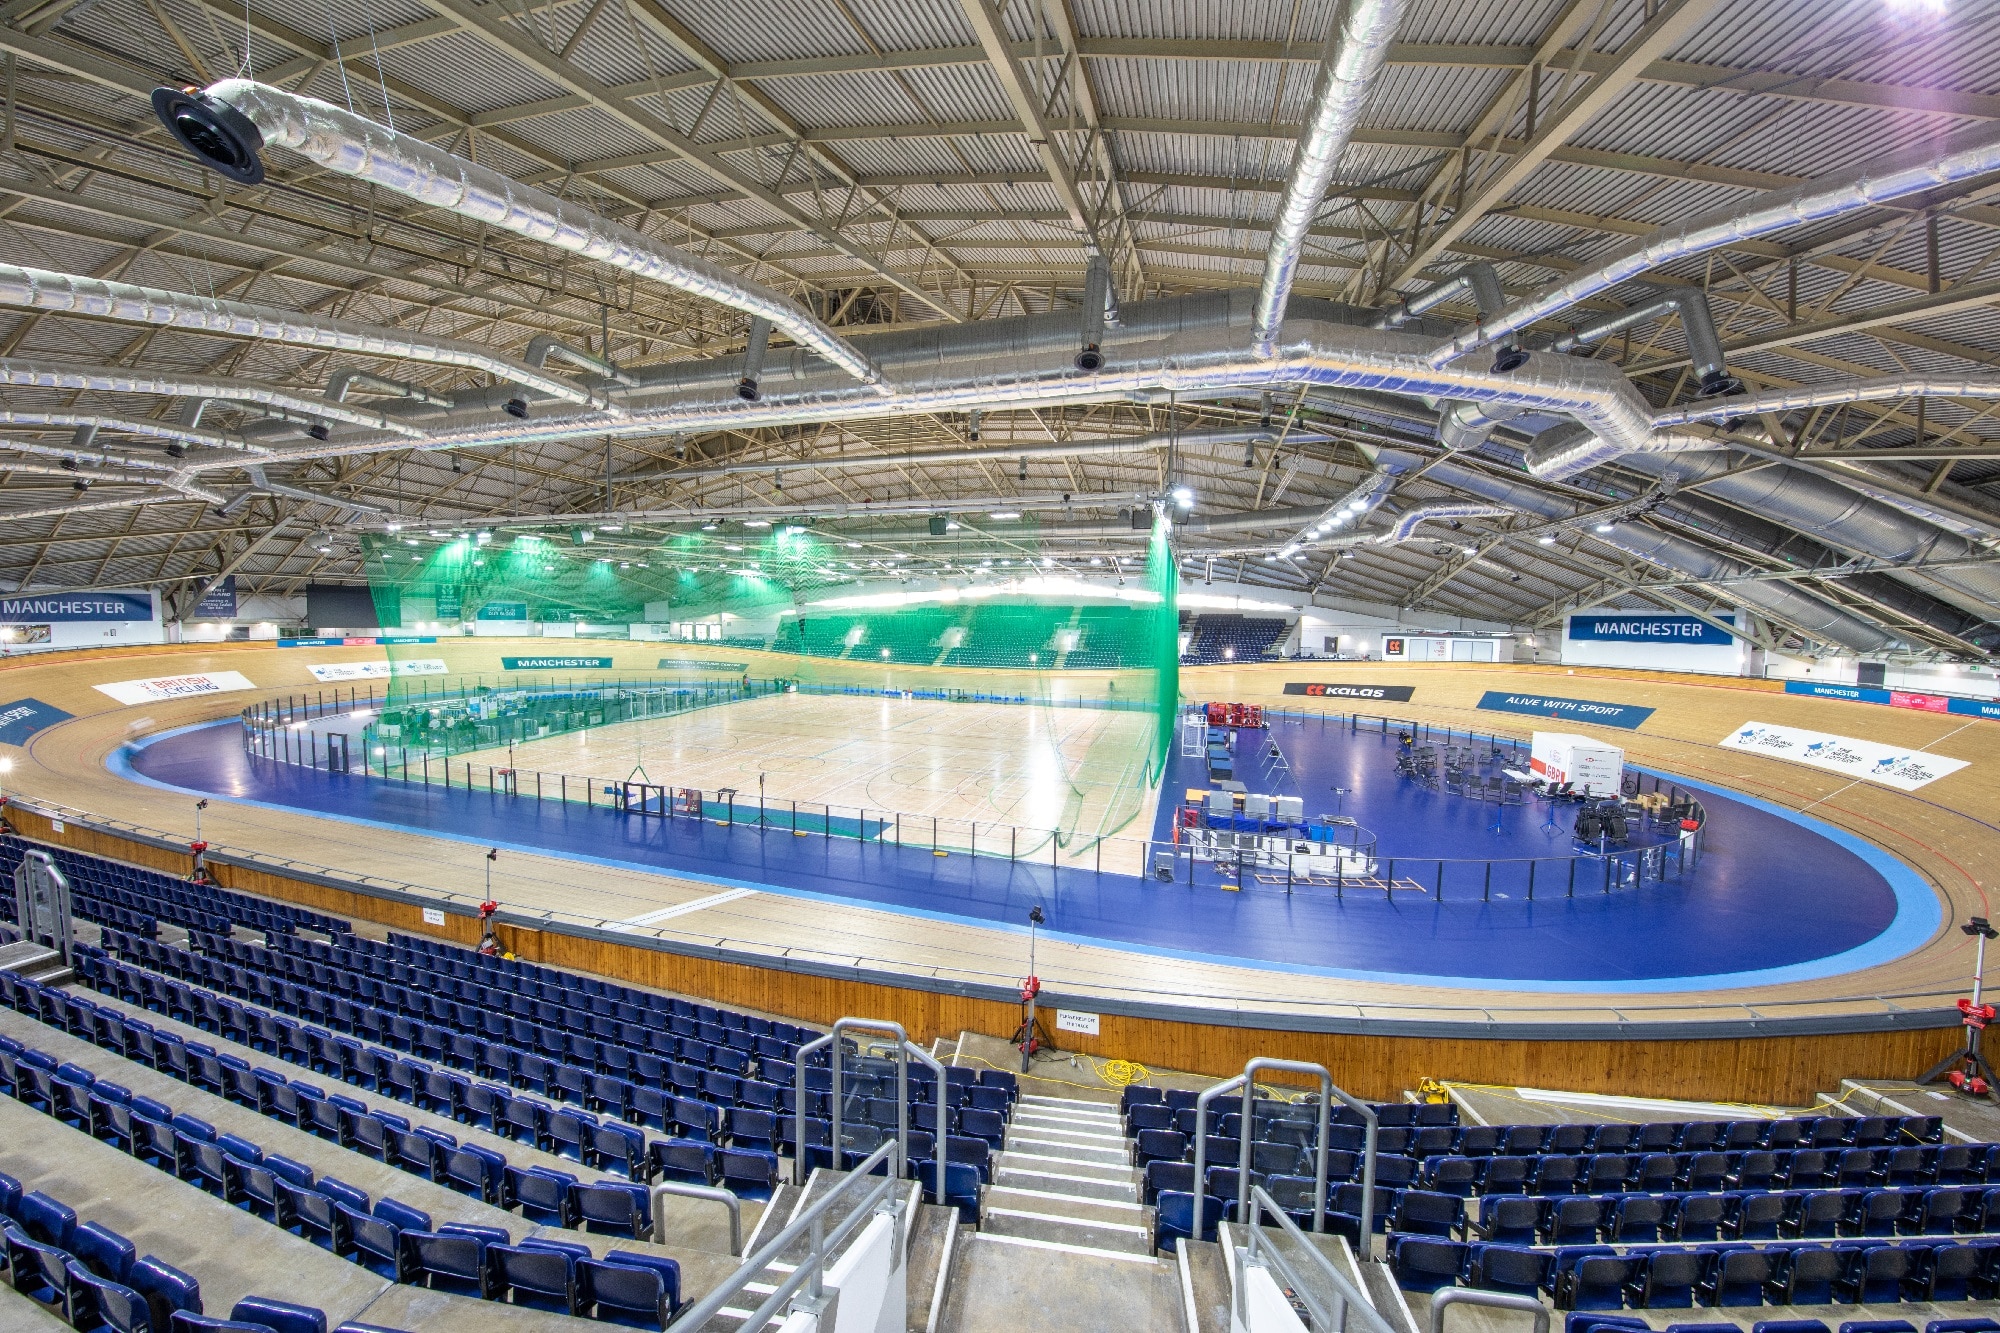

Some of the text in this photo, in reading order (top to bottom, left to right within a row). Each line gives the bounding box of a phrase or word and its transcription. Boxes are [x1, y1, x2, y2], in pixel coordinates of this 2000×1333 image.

[4, 600, 125, 614] MANCHESTER
[1594, 622, 1703, 637] MANCHESTER
[517, 659, 600, 667] MANCHESTER
[151, 676, 213, 689] BRITISH
[164, 683, 220, 695] CYCLING
[1814, 687, 1860, 698] MANCHESTER
[1505, 696, 1624, 716] ALIVE WITH SPORT
[1546, 764, 1561, 782] GBR
